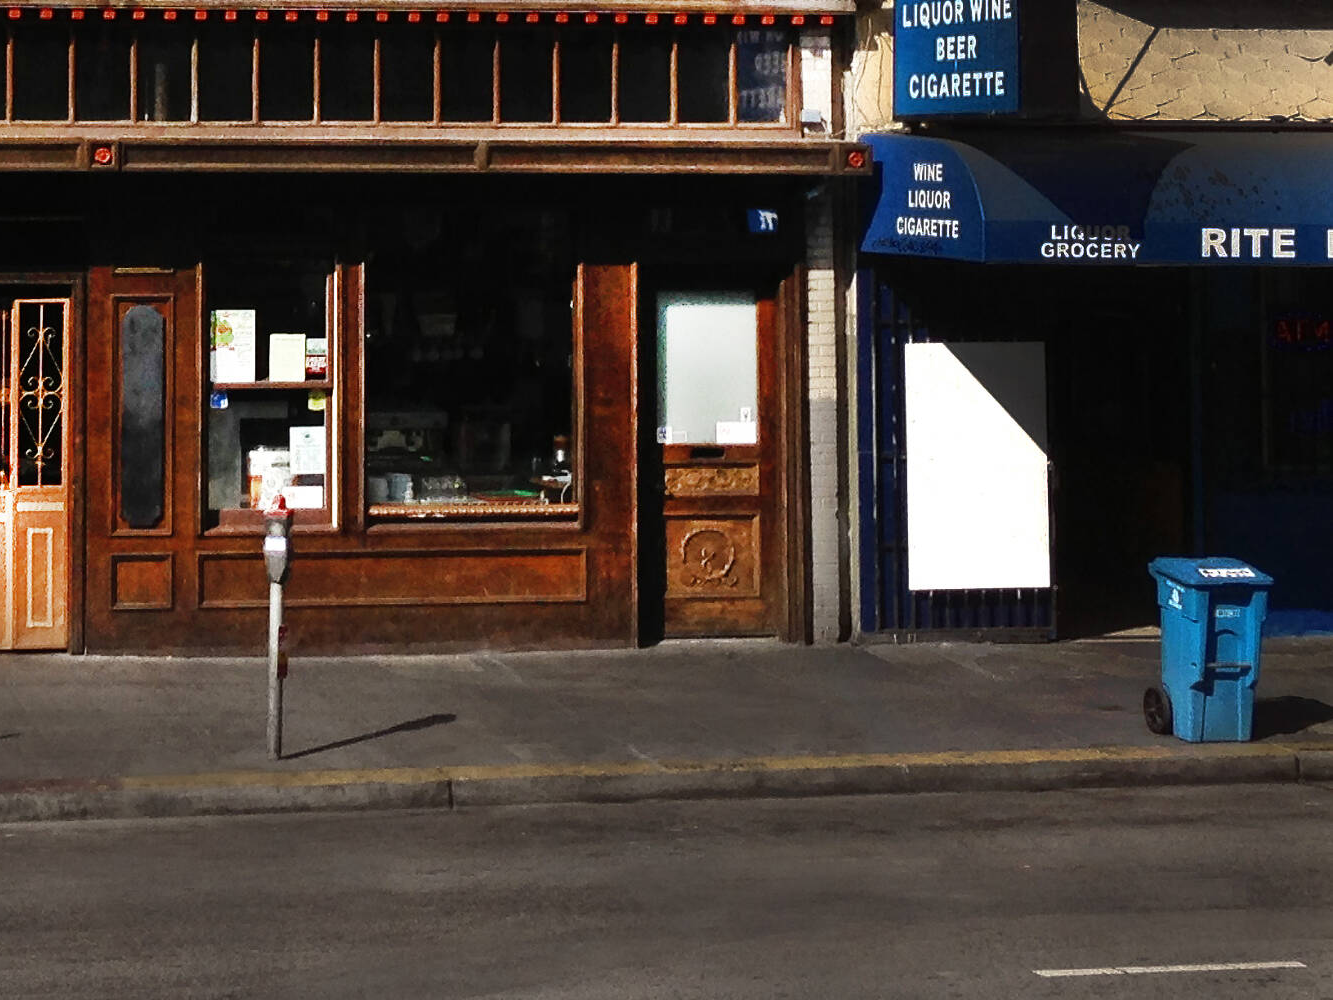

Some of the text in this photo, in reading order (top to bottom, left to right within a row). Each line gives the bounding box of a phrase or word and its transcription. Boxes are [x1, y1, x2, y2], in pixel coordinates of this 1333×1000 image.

[902, 0, 964, 29] LIQUOR
[936, 35, 977, 61] BEER
[909, 71, 1005, 99] CIGARETTE
[913, 163, 943, 182] WINE
[908, 189, 951, 209] LIQUOR
[896, 216, 960, 239] CIGARETTE
[1051, 224, 1130, 241] LIQUOR
[1040, 242, 1140, 259] GROCERY
[1201, 228, 1296, 258] RITE
